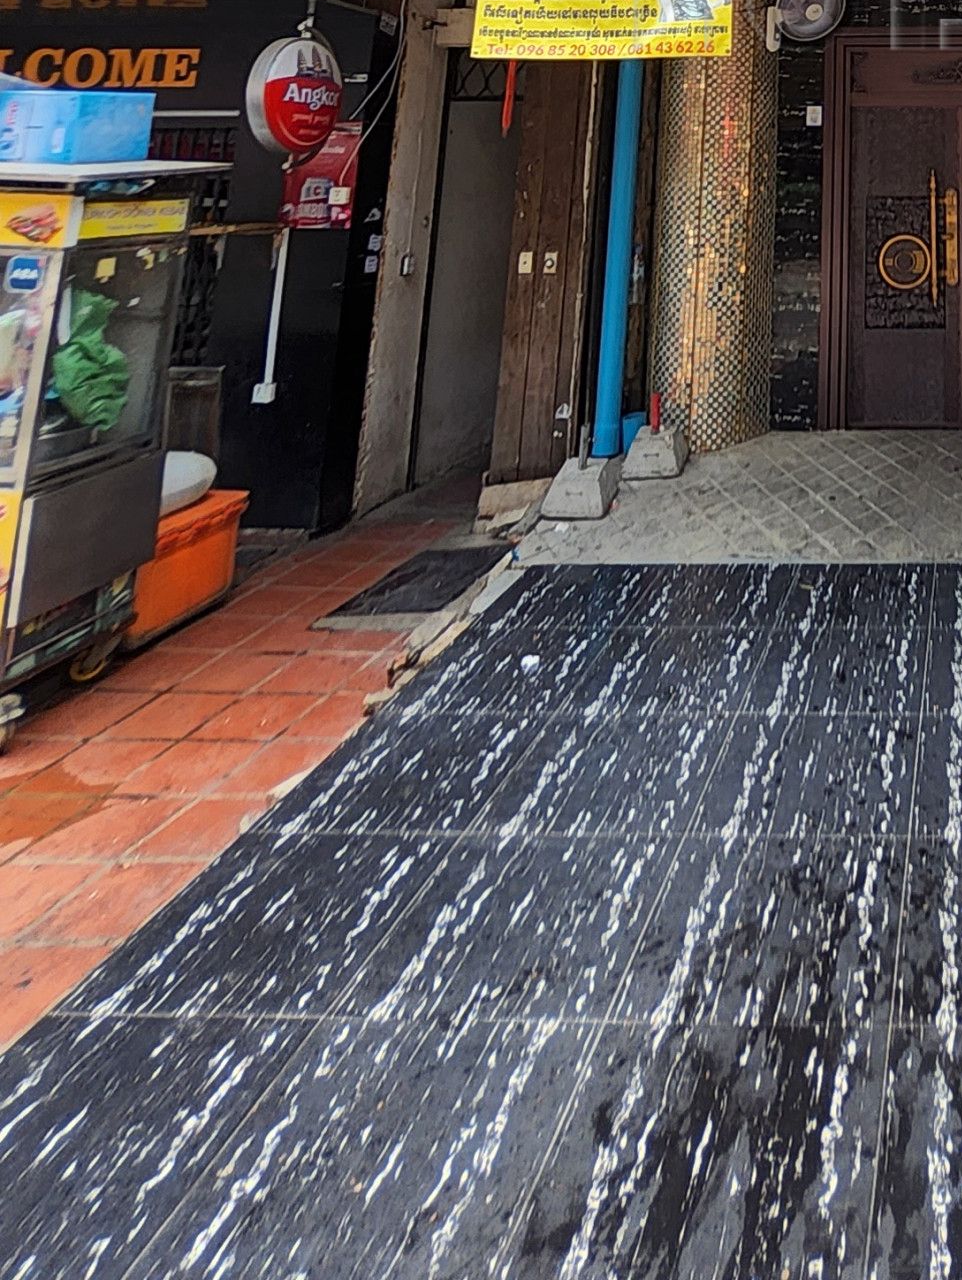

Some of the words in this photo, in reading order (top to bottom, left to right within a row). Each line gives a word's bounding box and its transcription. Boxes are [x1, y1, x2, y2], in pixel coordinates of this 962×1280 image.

[487, 44, 513, 55] Tel:
[517, 45, 544, 55] 096
[569, 44, 586, 55] 20
[590, 43, 615, 55] 308
[655, 42, 673, 54] 43
[676, 42, 693, 54] 62
[696, 41, 715, 53] 26
